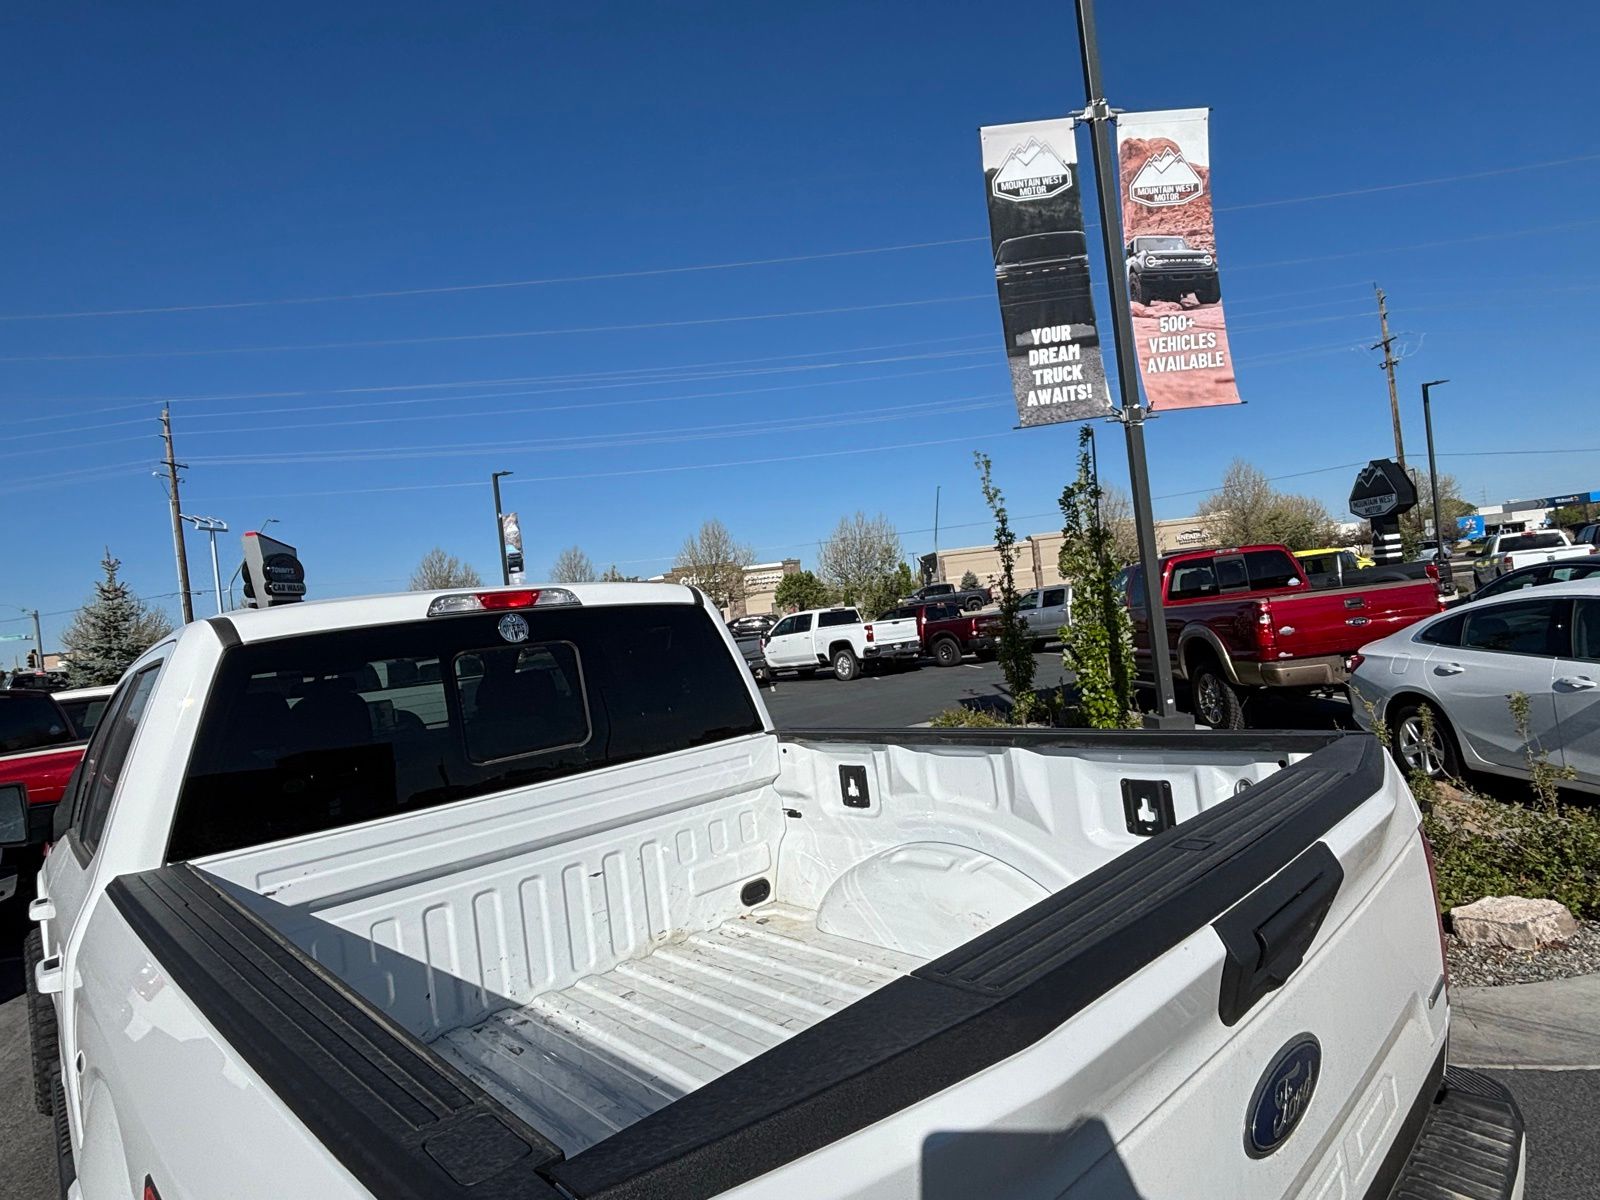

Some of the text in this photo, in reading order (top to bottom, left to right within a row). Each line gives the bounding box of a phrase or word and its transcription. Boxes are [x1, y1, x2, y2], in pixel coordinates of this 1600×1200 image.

[1001, 175, 1063, 191] MOUNTAIN WEST
[1019, 185, 1047, 196] MOTOR
[1137, 183, 1195, 195] MOUNTAIN WEST
[1154, 193, 1180, 202] MOTOR
[1159, 314, 1196, 333] 500+
[1030, 324, 1072, 345] YOUR
[1148, 332, 1217, 354] VEHICLES
[1028, 343, 1081, 366] DREAM
[1147, 350, 1225, 374] AVAILABLE
[1032, 363, 1083, 385] TRUCK
[1026, 383, 1093, 407] AWAITS!
[1353, 494, 1393, 507] MOUNTAIN WEST
[273, 583, 286, 592] CAR
[1273, 1060, 1313, 1138] Ford
